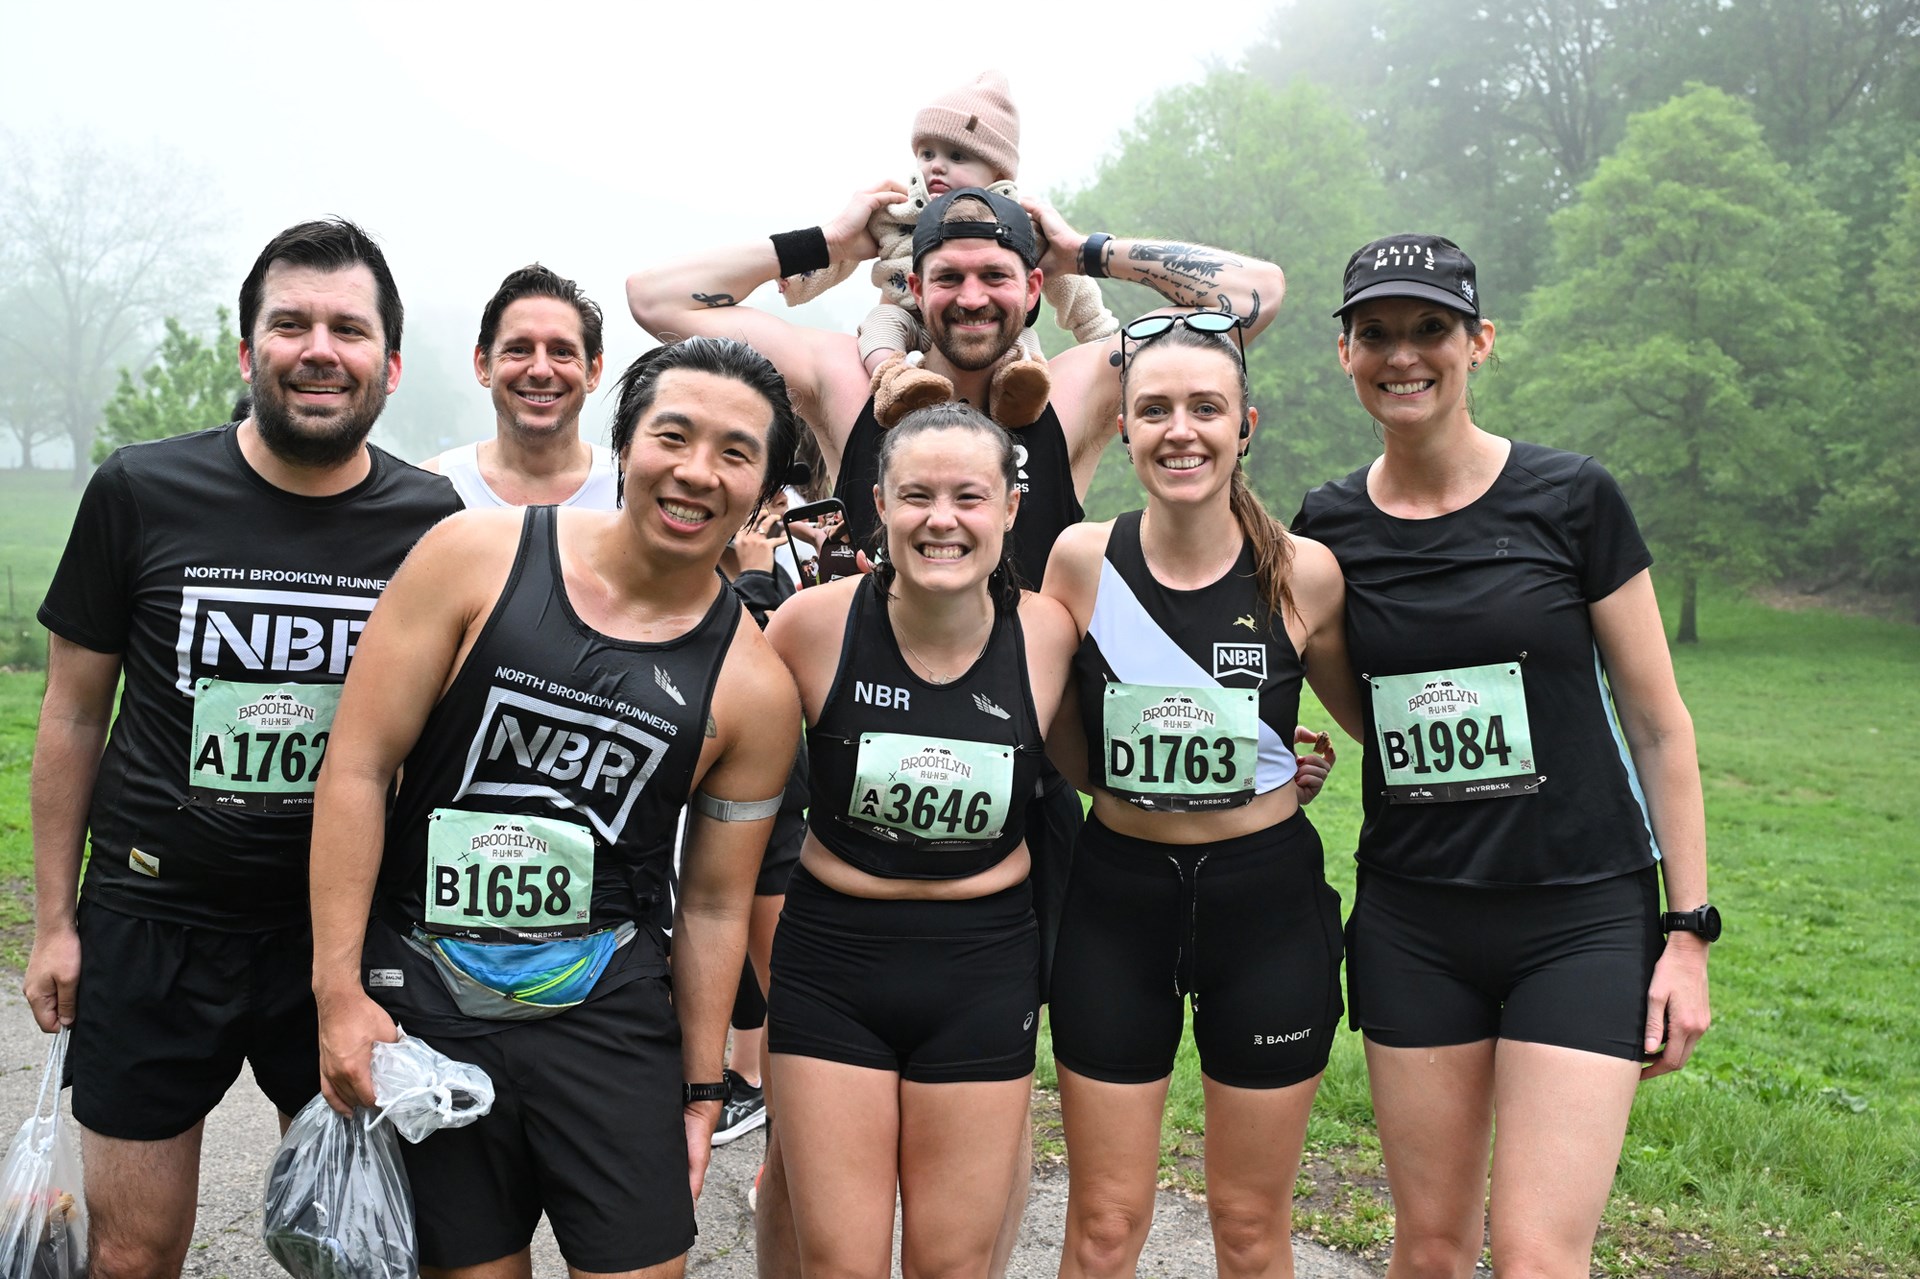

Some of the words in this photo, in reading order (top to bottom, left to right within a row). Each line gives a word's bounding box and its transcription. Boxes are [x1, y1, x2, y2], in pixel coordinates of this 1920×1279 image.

[184, 566, 244, 580] NORTH
[250, 569, 332, 586] BROOKLYN
[336, 576, 392, 592] RUNNE
[1219, 649, 1261, 666] NBR
[494, 666, 546, 690] NORTH
[547, 682, 614, 708] BROOKLYN
[615, 702, 678, 737] RUNNERS
[854, 680, 910, 712] NBR
[1408, 690, 1478, 712] BROOKLYN
[238, 702, 314, 720] BROOKLYN
[1142, 706, 1214, 725] BROOKLYN
[486, 714, 636, 796] NBR
[900, 756, 972, 778] BROOKLYN
[884, 783, 992, 834] 3646
[472, 834, 548, 854] BROOKLYN
[1266, 1028, 1312, 1044] BANDIT
